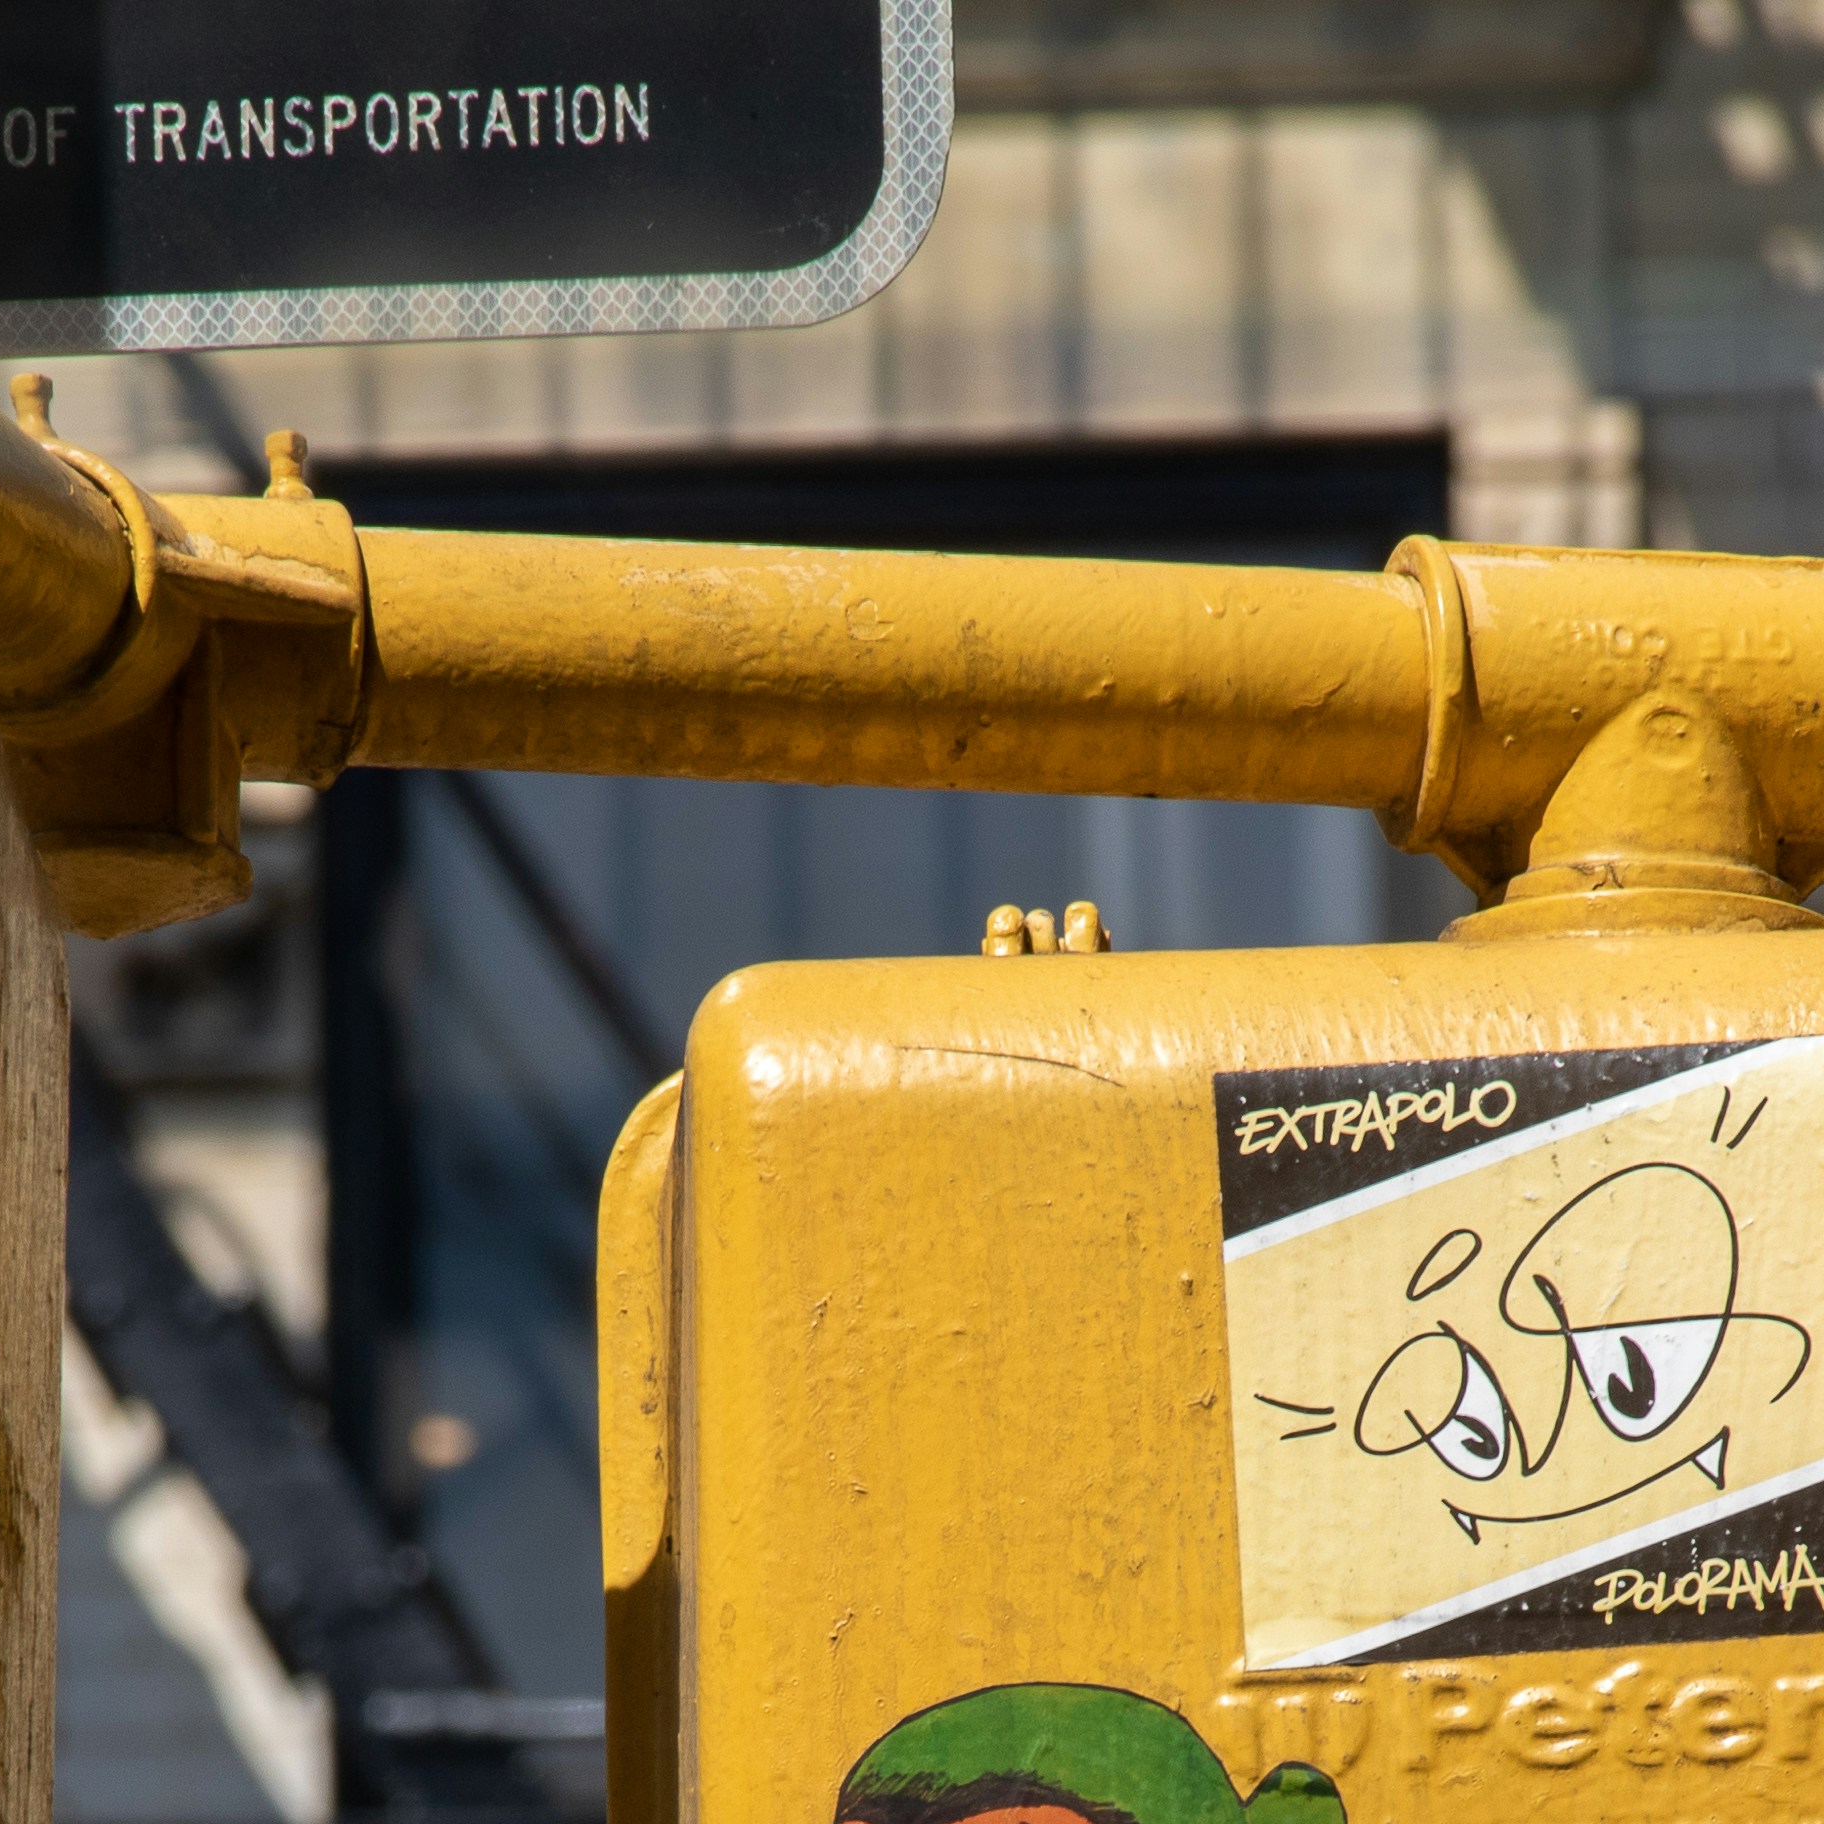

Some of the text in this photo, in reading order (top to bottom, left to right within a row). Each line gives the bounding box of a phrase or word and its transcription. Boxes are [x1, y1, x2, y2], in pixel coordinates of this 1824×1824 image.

[3, 104, 76, 168] OF
[113, 81, 651, 163] TRANSPORTATION
[1234, 1080, 1517, 1156] EXTRAPOLO
